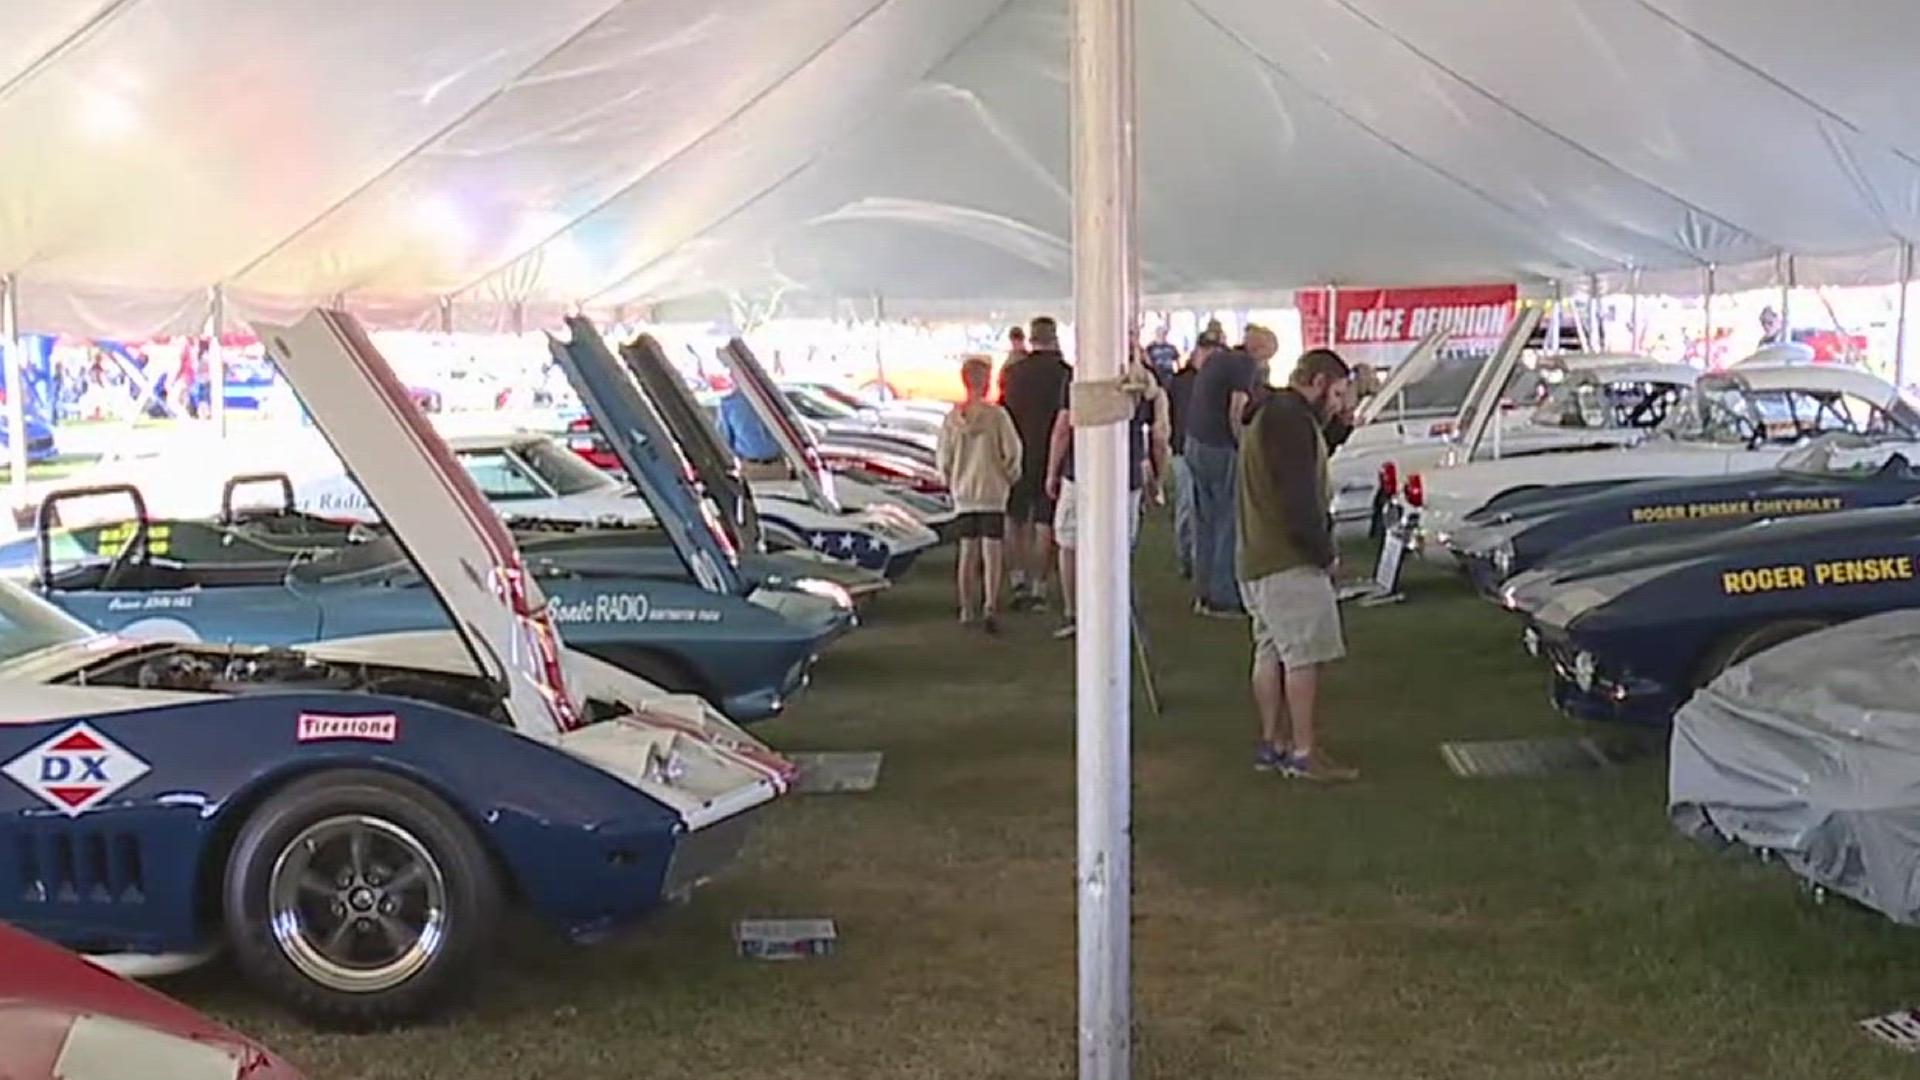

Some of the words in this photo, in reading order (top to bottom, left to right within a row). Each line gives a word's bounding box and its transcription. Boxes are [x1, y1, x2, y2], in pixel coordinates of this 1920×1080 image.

[1345, 308, 1404, 341] RACE
[1408, 303, 1506, 338] REUNION
[1632, 506, 1686, 522] ROGER
[1688, 501, 1750, 518] PENSKE
[1753, 498, 1841, 514] CHEVROLET
[1723, 565, 1806, 593] ROGER
[1814, 557, 1913, 585] PENSKE
[547, 595, 594, 622] Sonic
[596, 593, 649, 622] RADIO
[304, 718, 391, 734] Firestone
[41, 756, 109, 780] DX
